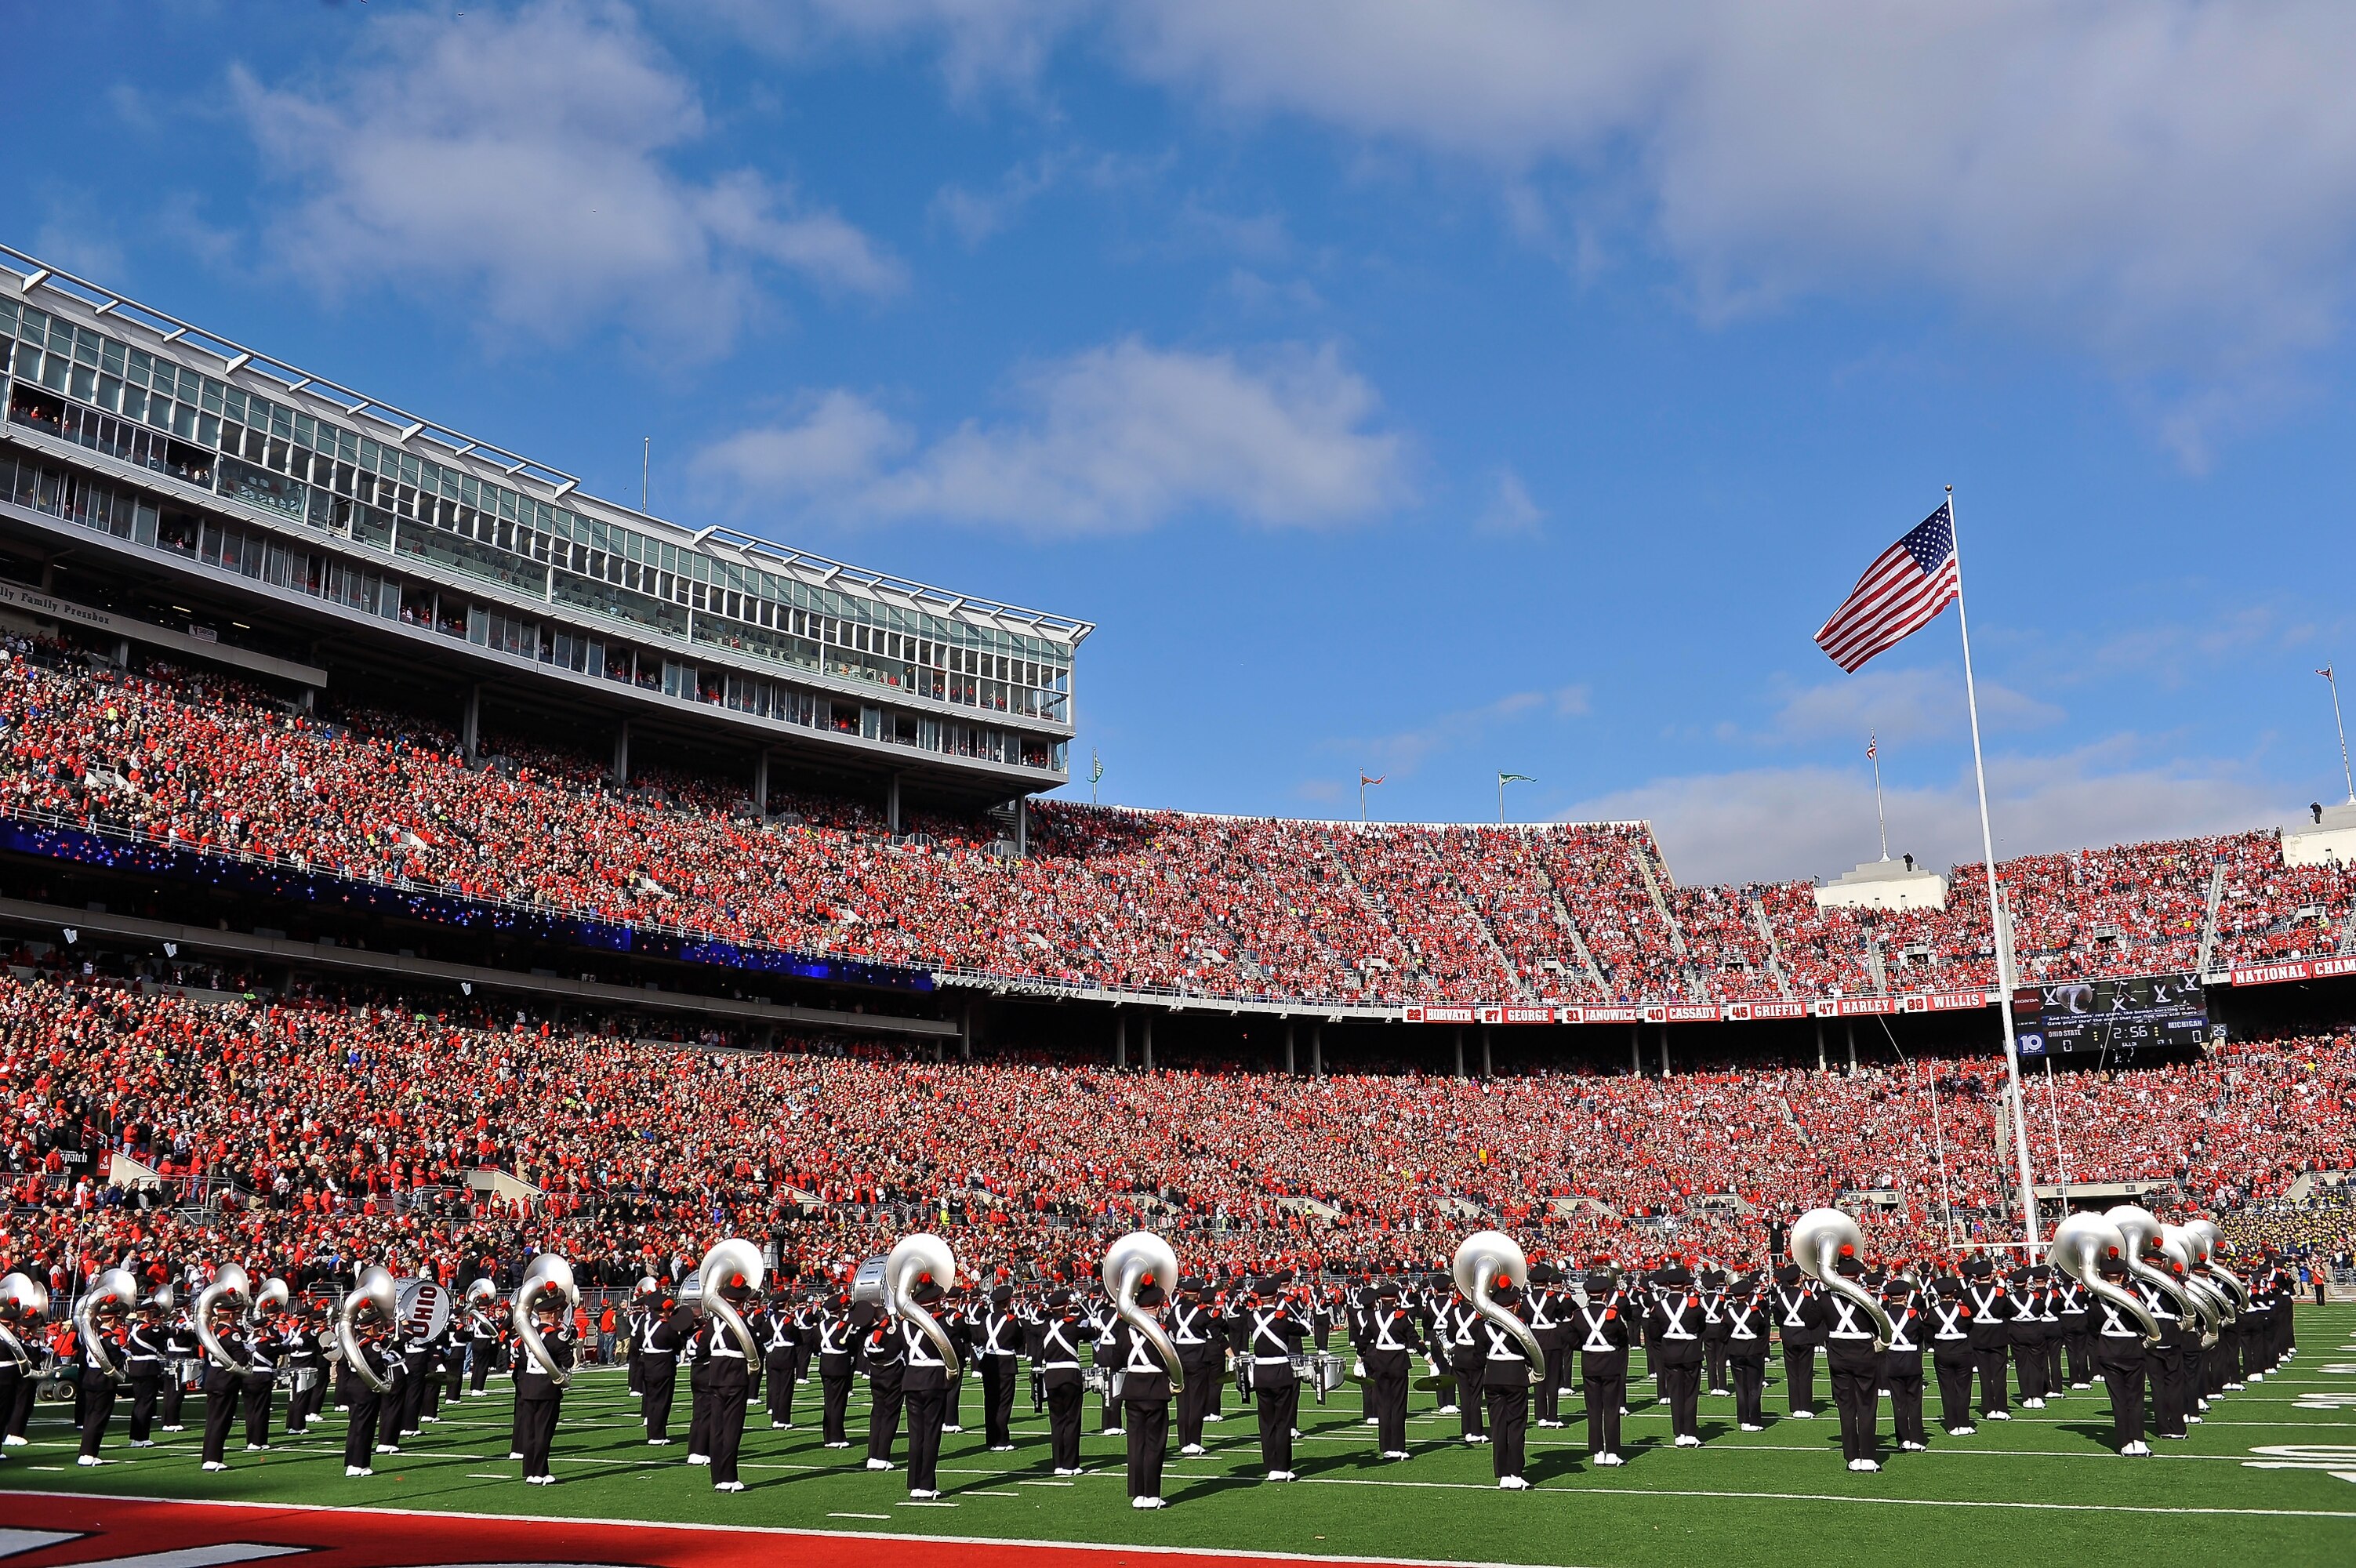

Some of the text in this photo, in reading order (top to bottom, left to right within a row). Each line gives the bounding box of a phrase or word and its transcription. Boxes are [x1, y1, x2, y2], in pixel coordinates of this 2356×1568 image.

[20, 593, 58, 612] Family
[64, 604, 110, 624] Pressbox
[2234, 964, 2307, 984] NATIONAL
[1818, 1000, 1891, 1015] 47 HARLEY
[1932, 993, 1980, 1009] WILLIS
[1407, 1008, 1472, 1022] 22 HORVATH
[1485, 1009, 1549, 1022] 27 GEORGE
[1584, 1008, 1637, 1022] JANOWICZ
[1647, 1007, 1718, 1020] 40 CASSADY
[1732, 1004, 1803, 1018] 45 GRIFFIN
[2167, 1020, 2203, 1029] MICHIGAN
[2213, 1025, 2227, 1036] 25
[2113, 1025, 2148, 1039] 2:56
[2192, 1030, 2202, 1043] 0
[2020, 1034, 2042, 1051] 10
[2062, 1040, 2072, 1052] 0
[60, 1152, 88, 1164] spatch
[405, 1286, 438, 1338] OHIO
